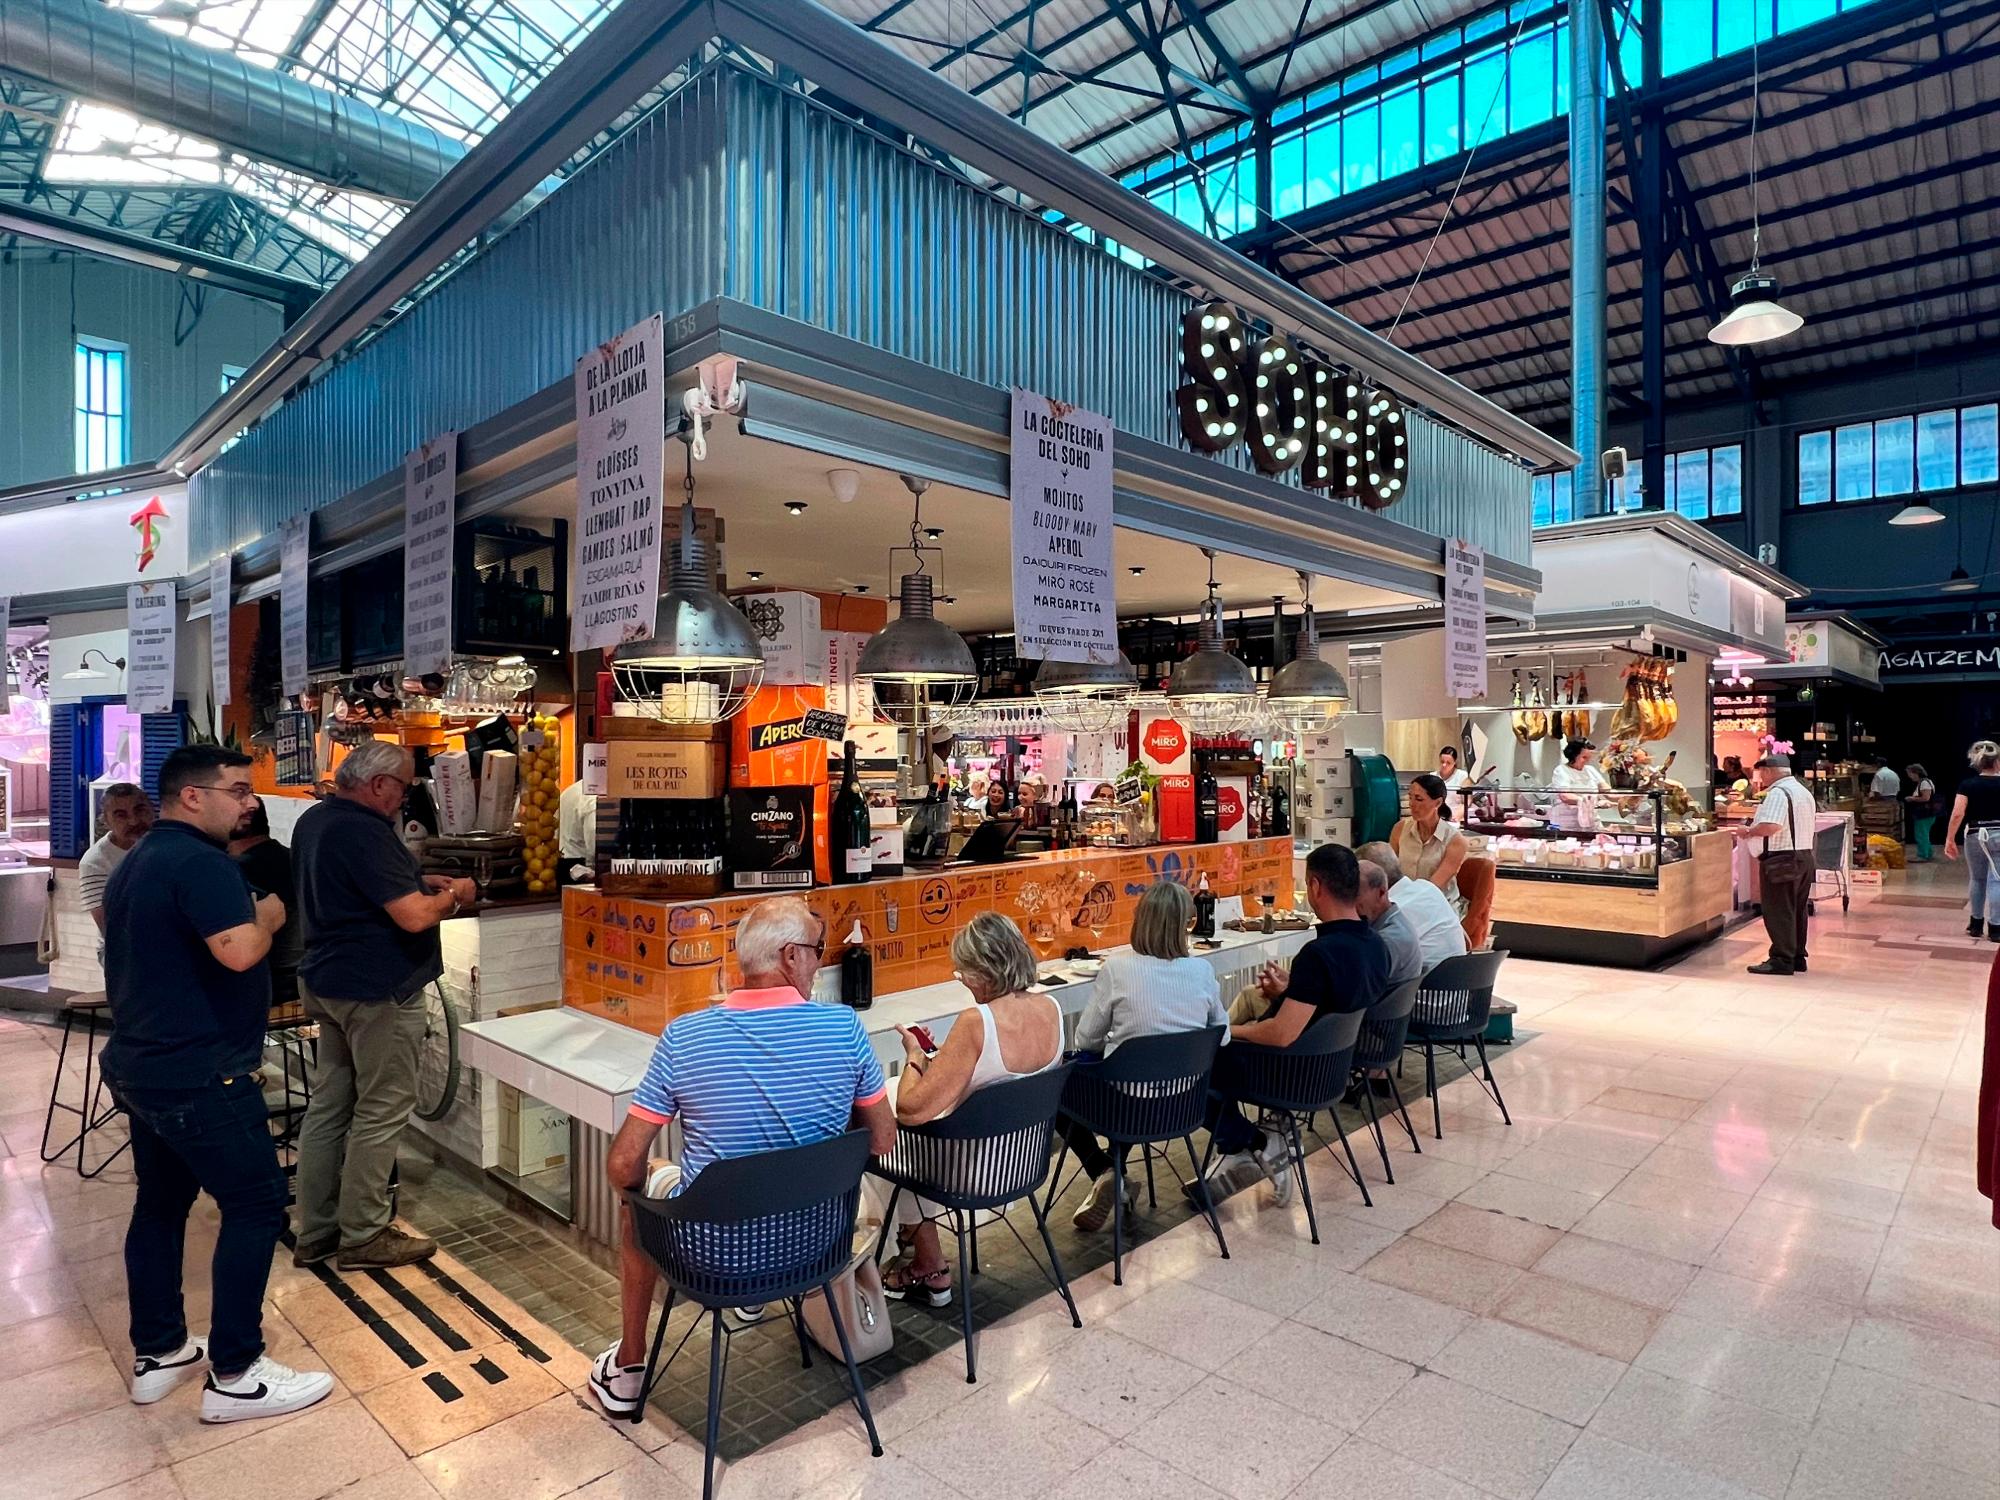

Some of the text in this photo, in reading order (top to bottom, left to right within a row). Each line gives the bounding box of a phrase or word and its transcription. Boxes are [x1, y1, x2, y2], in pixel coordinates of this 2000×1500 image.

[674, 315, 697, 341] 138
[587, 341, 645, 391] DE LA LLOTJA
[589, 369, 648, 417] A LA PLANXA
[1177, 302, 1408, 508] SOHO
[1023, 410, 1104, 452] LA COCTELERÍA
[597, 445, 639, 480] CLOÏSSES
[1038, 438, 1090, 470] DEL SOHO
[590, 474, 645, 507] TONYINA
[1043, 486, 1084, 512] MOJITOS
[585, 496, 651, 537] LLENGUAT RAP
[1032, 510, 1098, 538] BLOODY MARY
[582, 521, 653, 566] GAMBES SALMÓ
[1048, 535, 1084, 558] APEROL
[1022, 556, 1108, 578] DAIQUIRI FROZEN
[581, 580, 645, 607] ZAMBURIÑAS
[1038, 572, 1095, 594] MIRÓ ROSÉ
[584, 603, 639, 628] LLAGOSTINS
[1033, 594, 1102, 614] MARGARITA
[1023, 635, 1033, 643] EN
[1039, 624, 1066, 635] JUEVES
[1066, 627, 1090, 637] TARDE
[829, 639, 839, 712] TAITTINGER
[760, 721, 803, 747] APERO
[1151, 736, 1179, 747] MIRÓ
[588, 759, 607, 768] MIR
[626, 766, 688, 780] LES ROTES
[633, 780, 644, 790] DE
[646, 781, 662, 791] CAL
[1163, 777, 1190, 788] MIRÓ
[1218, 802, 1236, 813] IRÓ
[1296, 793, 1313, 808] VINE
[751, 810, 794, 822] CINZANO
